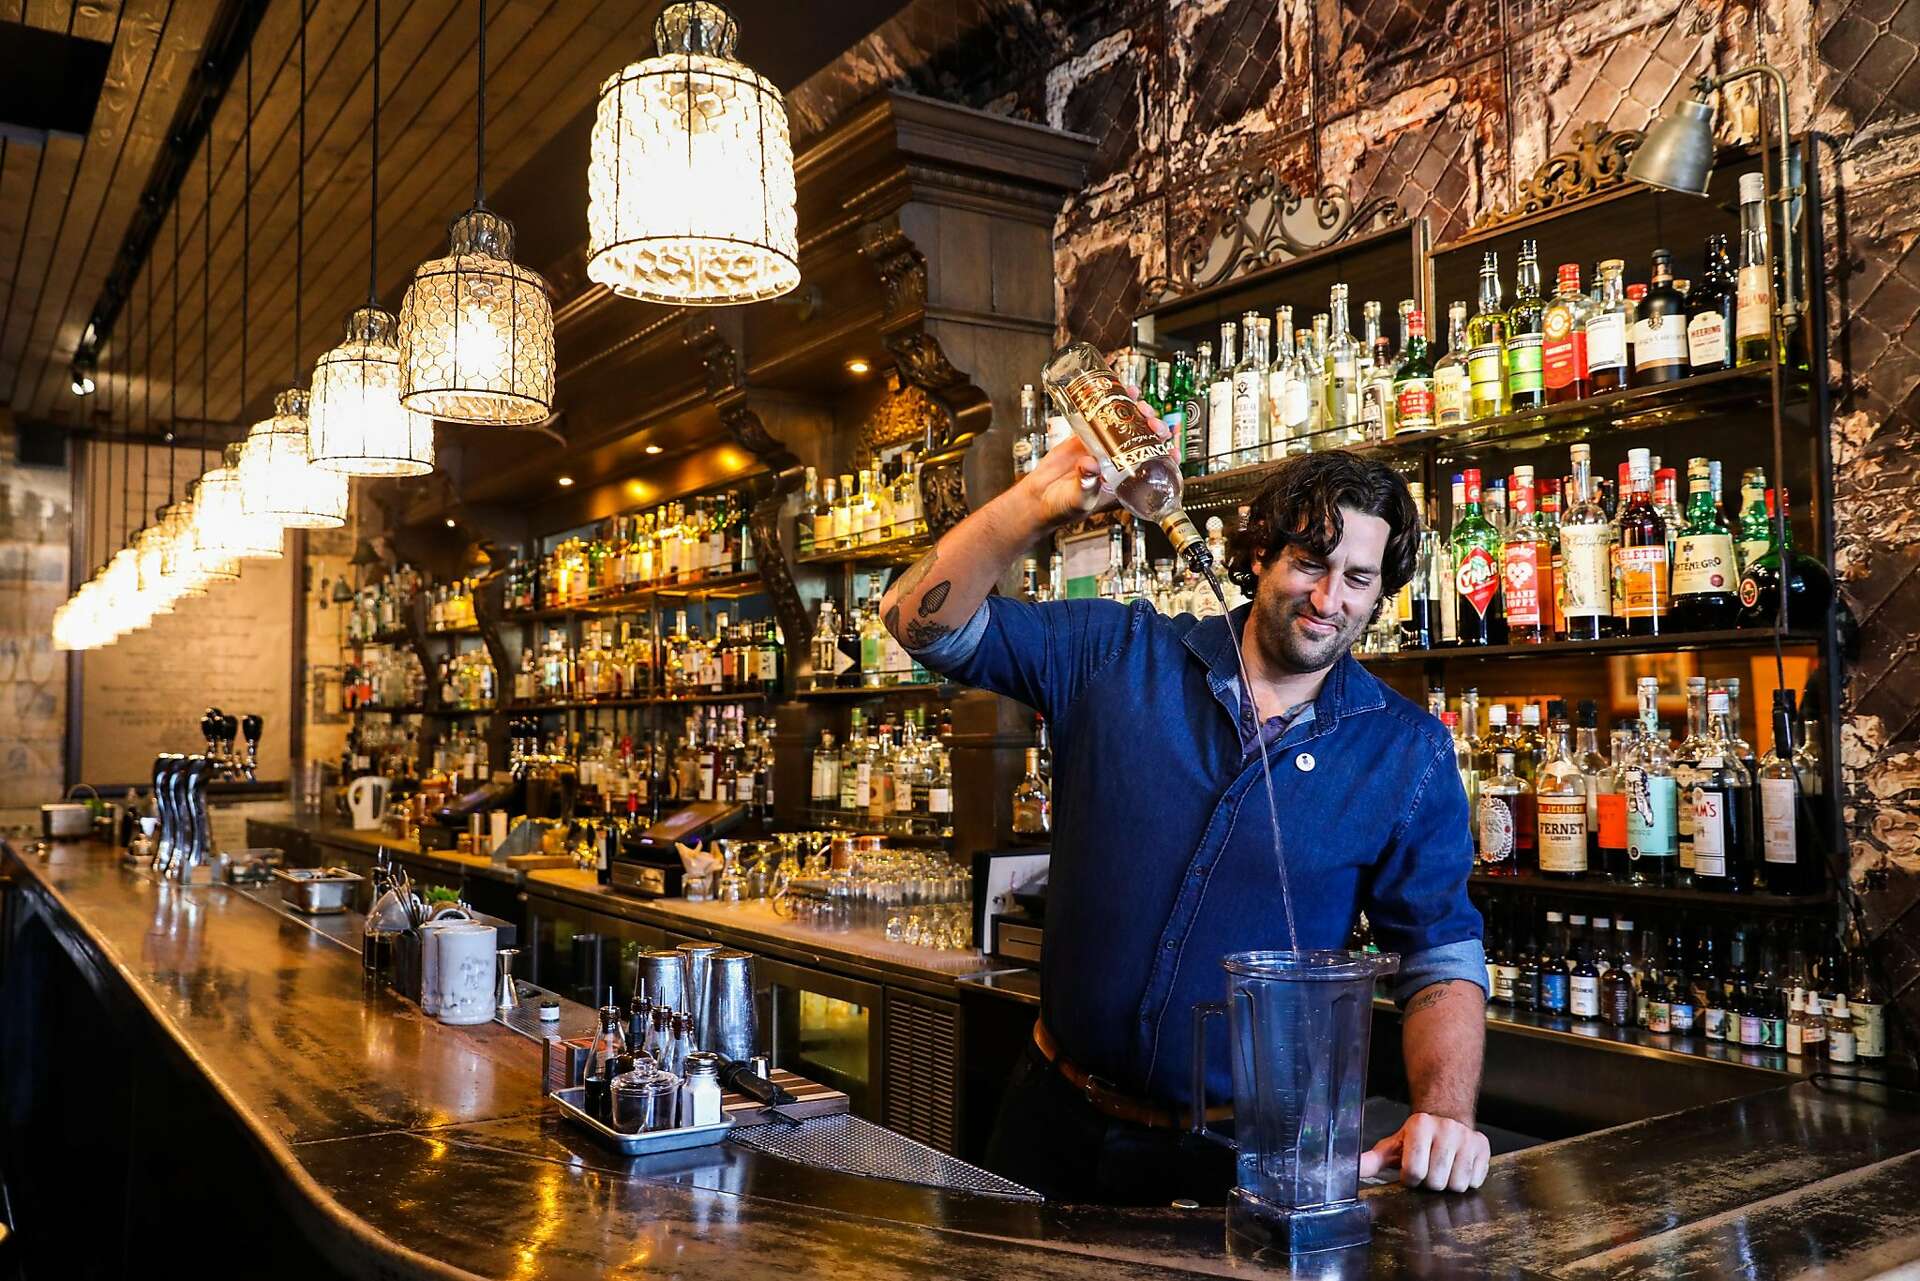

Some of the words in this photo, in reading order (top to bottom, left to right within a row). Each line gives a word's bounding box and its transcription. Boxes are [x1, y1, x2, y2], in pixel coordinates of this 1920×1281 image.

[1620, 549, 1664, 560] ELETTI
[1674, 556, 1722, 571] NTENEGRO
[1456, 561, 1498, 595] CYNAR
[1539, 822, 1585, 835] FERNET
